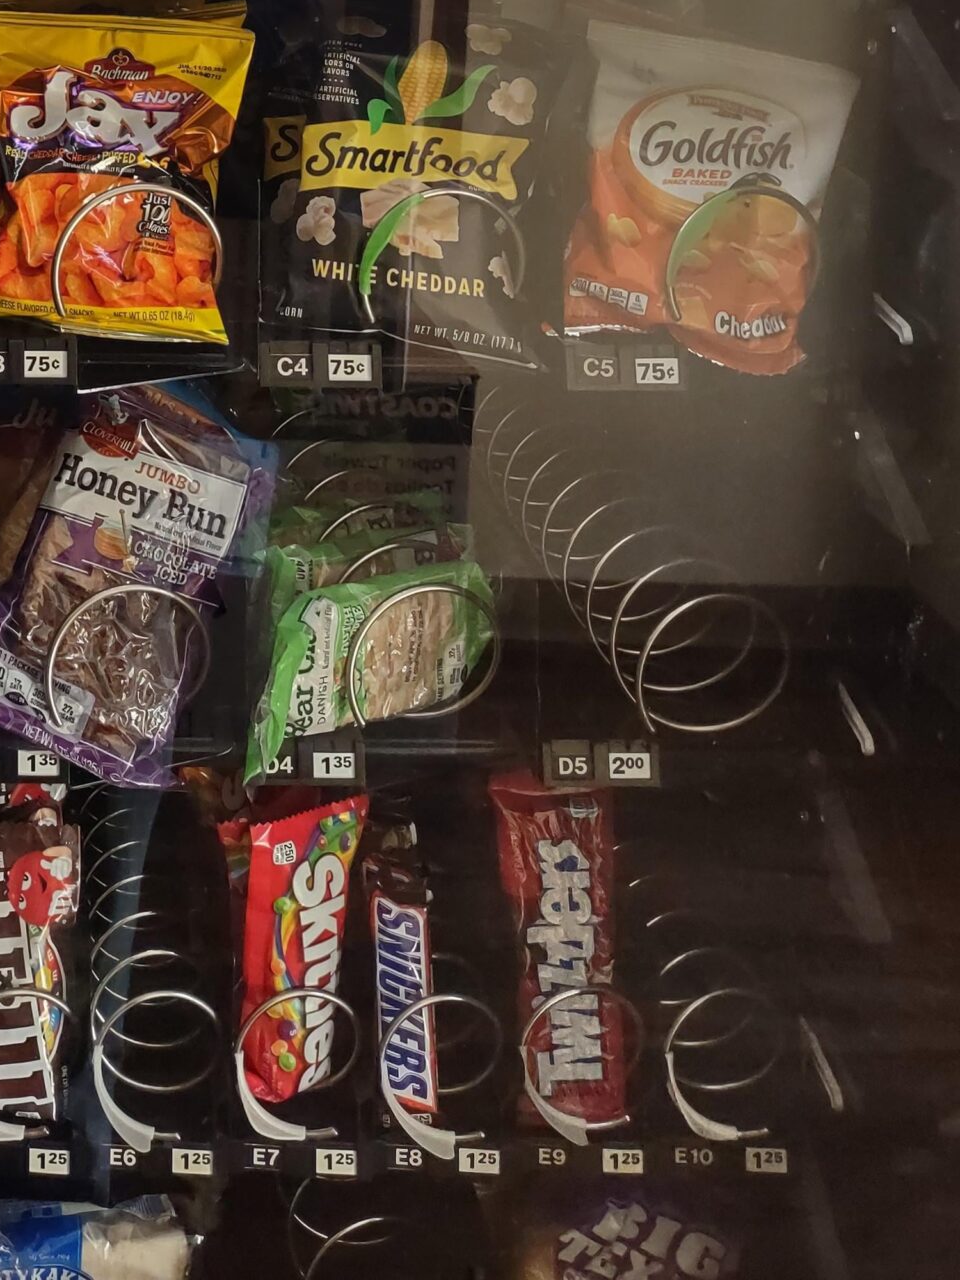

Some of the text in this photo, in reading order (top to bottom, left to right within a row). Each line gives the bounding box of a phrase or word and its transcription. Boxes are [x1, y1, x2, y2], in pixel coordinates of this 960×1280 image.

[91, 64, 149, 81] Bachman
[10, 71, 182, 155] Jax
[640, 120, 792, 170] Goldfish
[305, 131, 507, 184] Smartfood
[671, 168, 733, 180] BAKED
[312, 258, 486, 298] WHIE CHEDDAR
[142, 310, 159, 321] 0.65
[715, 311, 787, 340] Cheddar
[25, 356, 60, 372] 75¢
[277, 357, 308, 376] C4
[330, 360, 365, 376] 75¢
[583, 357, 614, 377] C5
[637, 361, 676, 381] 75¢
[82, 422, 138, 456] CLOVERHILL
[135, 461, 201, 495] JUMBO
[53, 452, 159, 519] Honey
[162, 491, 228, 539] Bun
[154, 564, 188, 586] ICED
[26, 754, 58, 773] 135
[320, 756, 353, 776] 135
[559, 757, 588, 775] D5
[611, 756, 645, 775] 200
[377, 900, 429, 1100] SNICKERS
[37, 1153, 67, 1169] 125
[110, 1149, 136, 1166] E6
[180, 1154, 211, 1170] 125
[253, 1149, 279, 1166] E7
[323, 1153, 355, 1170] 125
[395, 1149, 423, 1166] E8
[466, 1152, 497, 1170] 125
[539, 1148, 566, 1166] E9
[609, 1152, 640, 1170] 125
[674, 1148, 713, 1166] E10
[752, 1151, 784, 1169] 125
